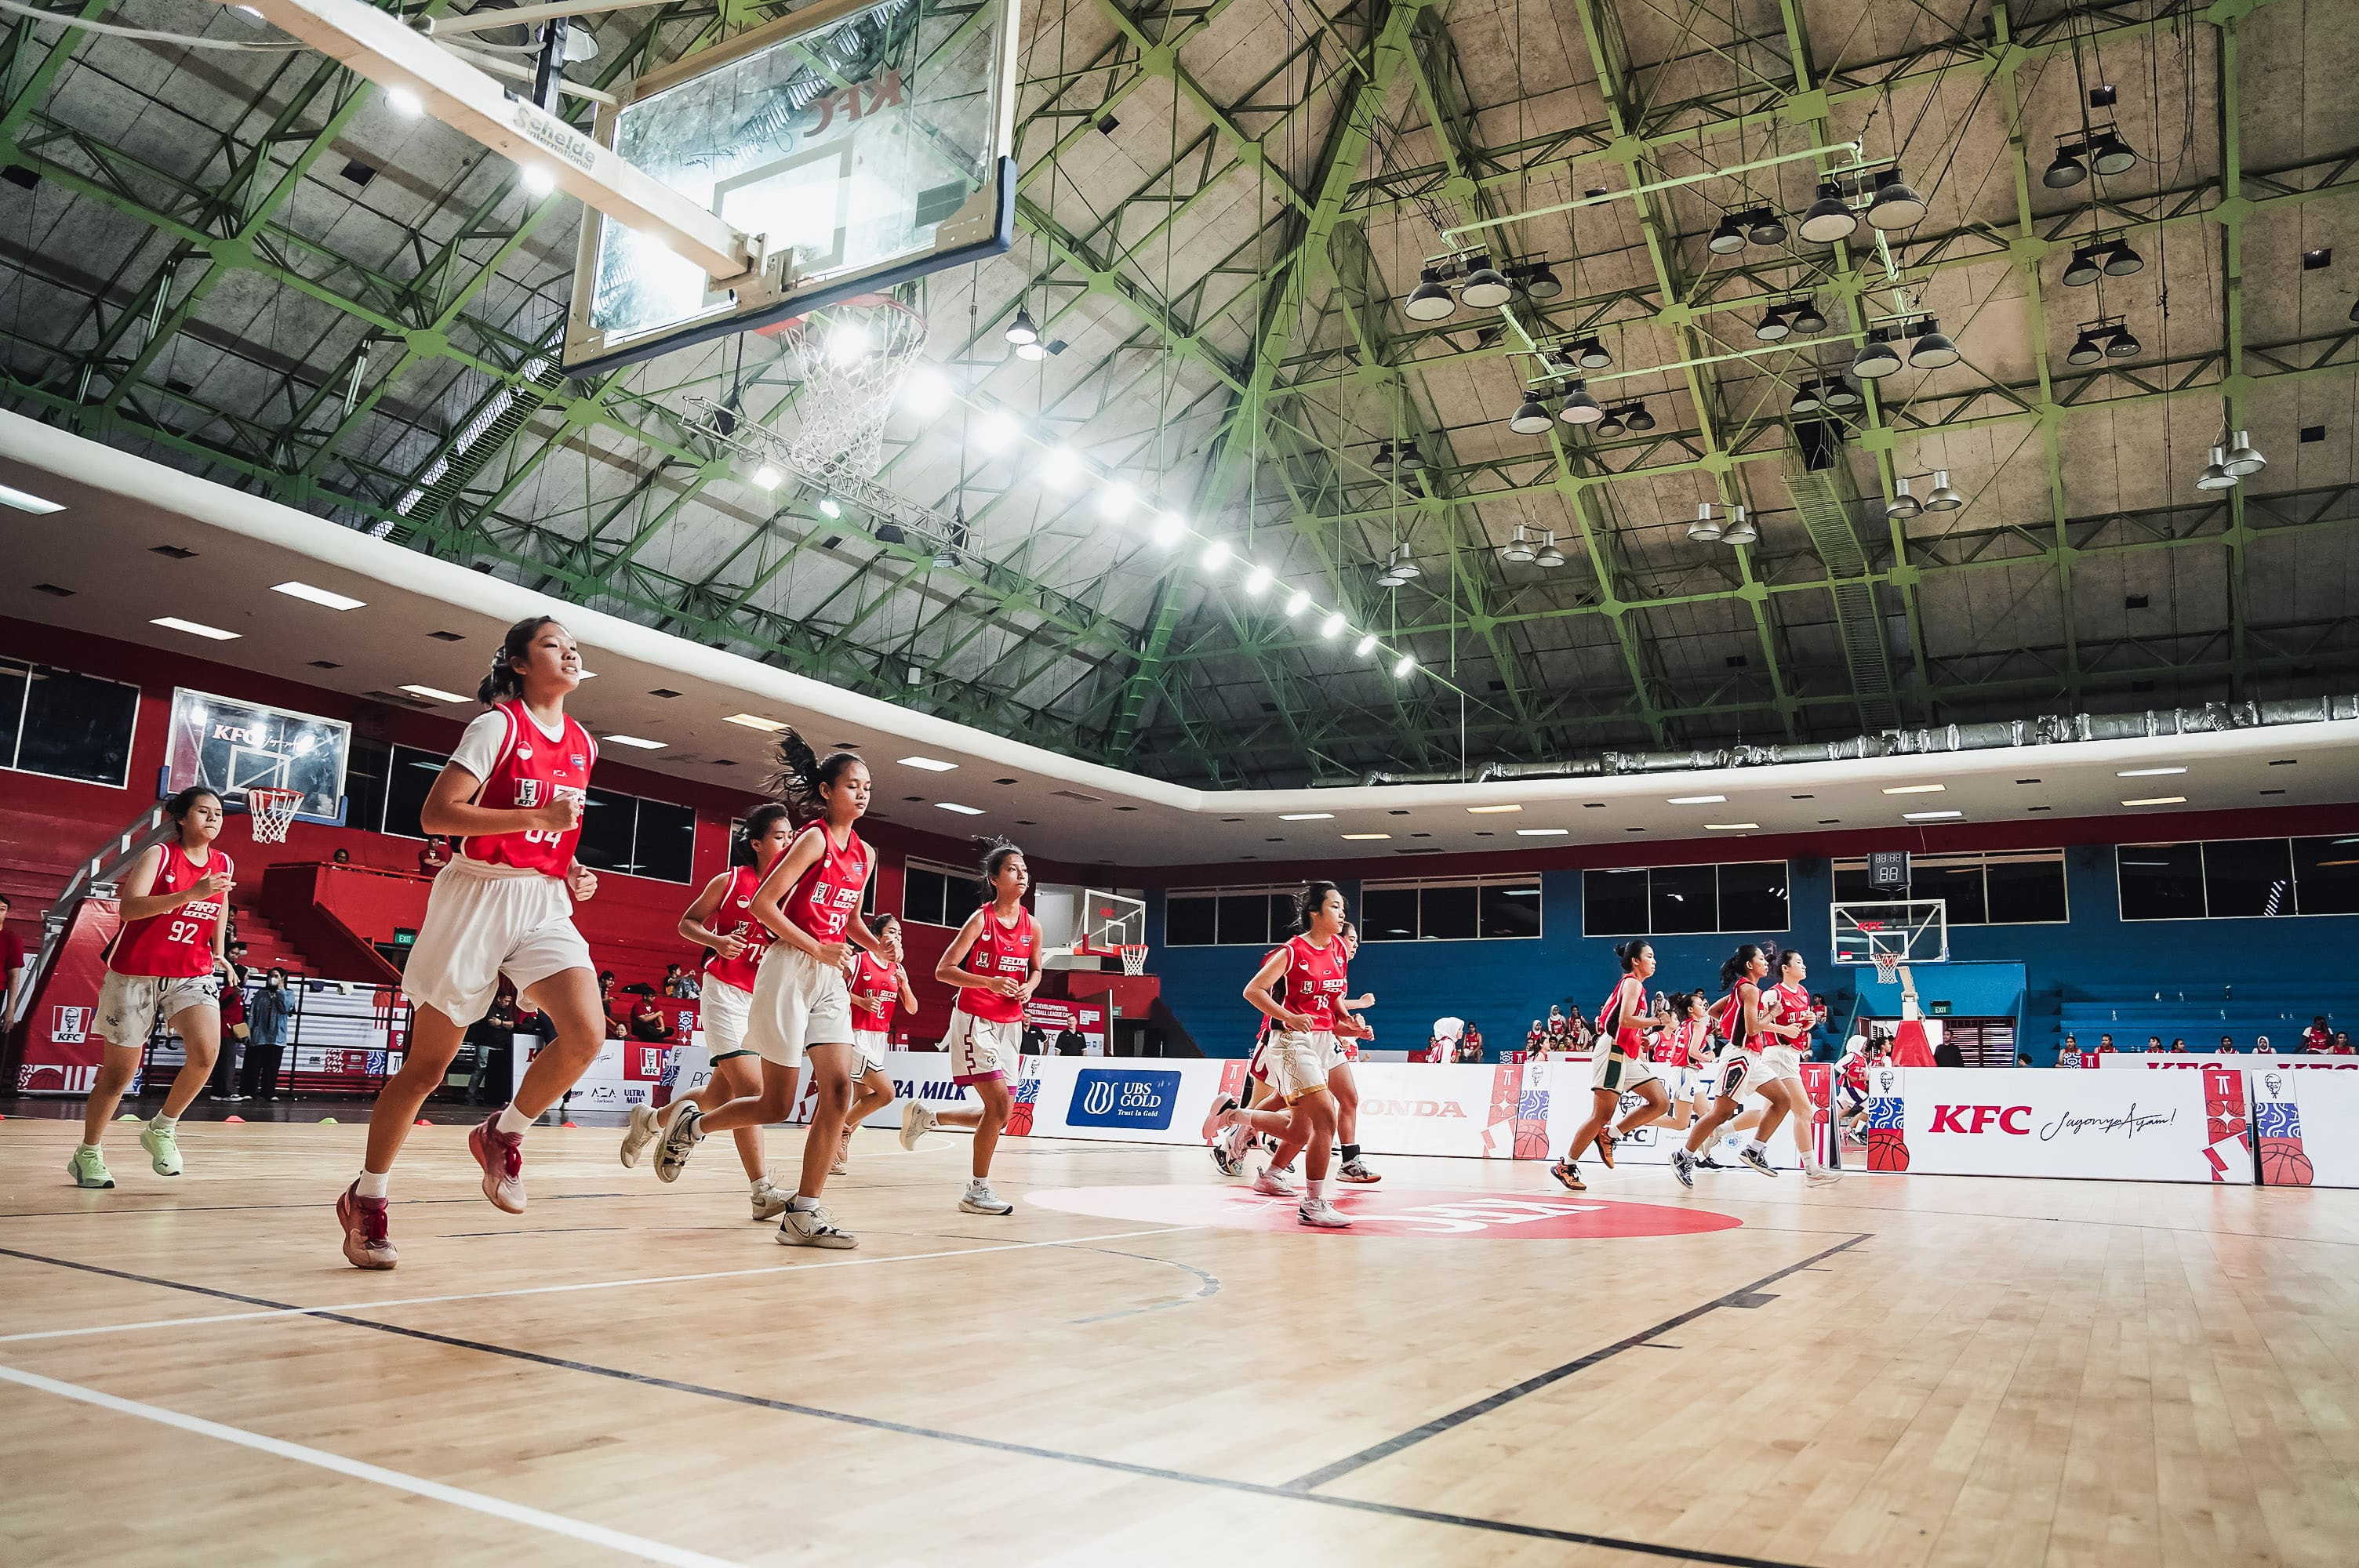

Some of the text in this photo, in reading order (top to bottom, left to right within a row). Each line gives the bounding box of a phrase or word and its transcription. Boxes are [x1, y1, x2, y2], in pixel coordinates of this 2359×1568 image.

[513, 106, 596, 164] Schelde
[526, 128, 594, 170] international
[835, 888, 861, 903] FIRS
[167, 920, 199, 945] 92
[1857, 921, 1885, 931] KFC
[398, 935, 412, 943] EXIT
[56, 1033, 82, 1042] KFC
[918, 1080, 968, 1102] MILK
[1123, 1082, 1152, 1095] UBS
[1120, 1094, 1161, 1108] GOLD
[1359, 1098, 1467, 1118] ONDA
[1928, 1105, 2033, 1135] KFC
